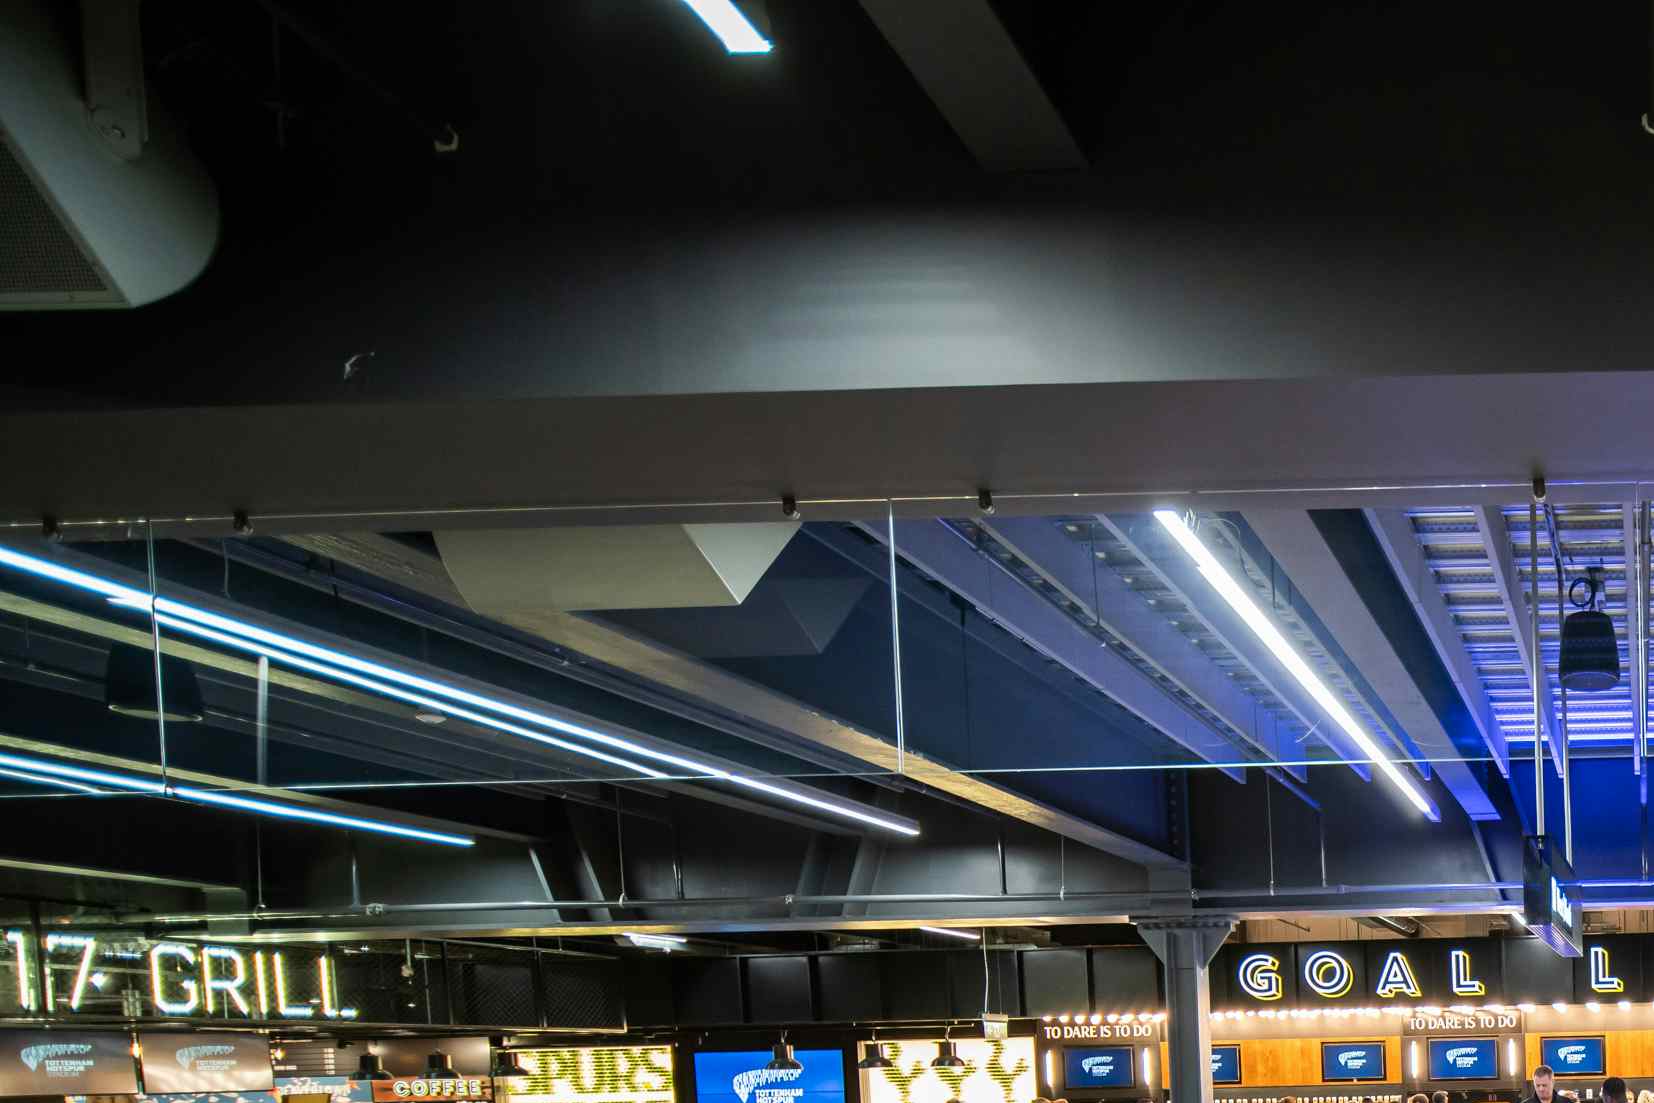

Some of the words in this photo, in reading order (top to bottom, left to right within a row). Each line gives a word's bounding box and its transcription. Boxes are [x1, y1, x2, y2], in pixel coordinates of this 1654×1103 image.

[150, 943, 359, 1019] GRILL
[1239, 950, 1486, 1000] GOAL
[1409, 1017, 1425, 1030] TO
[1428, 1017, 1461, 1030] DARE
[1464, 1016, 1476, 1029] IS
[1479, 1016, 1495, 1028] TO
[1498, 1015, 1517, 1028] DO
[1044, 1026, 1062, 1039] TO
[1063, 1025, 1098, 1039] DARE
[1100, 1025, 1111, 1038] IS
[1114, 1024, 1130, 1038] TO
[1133, 1024, 1152, 1037] DO
[393, 1079, 482, 1097] COFFEE
[755, 1088, 804, 1097] TOTTENHAM
